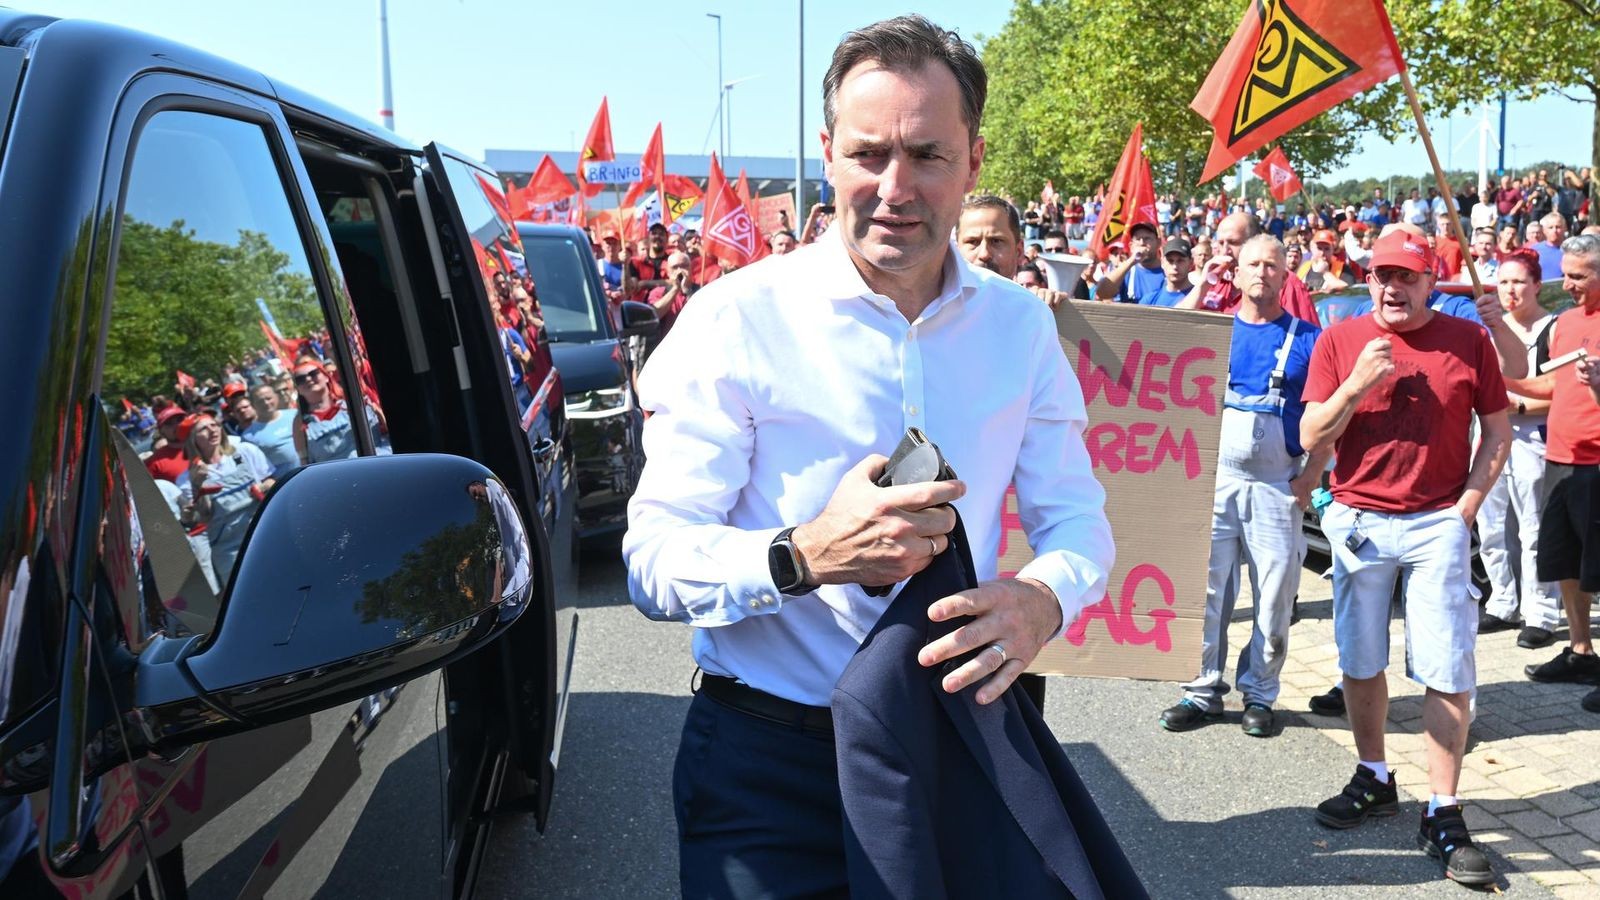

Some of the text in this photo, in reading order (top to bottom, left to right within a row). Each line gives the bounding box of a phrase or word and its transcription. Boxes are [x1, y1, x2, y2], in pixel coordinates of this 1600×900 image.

[589, 166, 641, 182] BR-INFO
[1077, 339, 1216, 417] WEG
[1085, 421, 1201, 480] REM
[1065, 563, 1177, 653] AG
